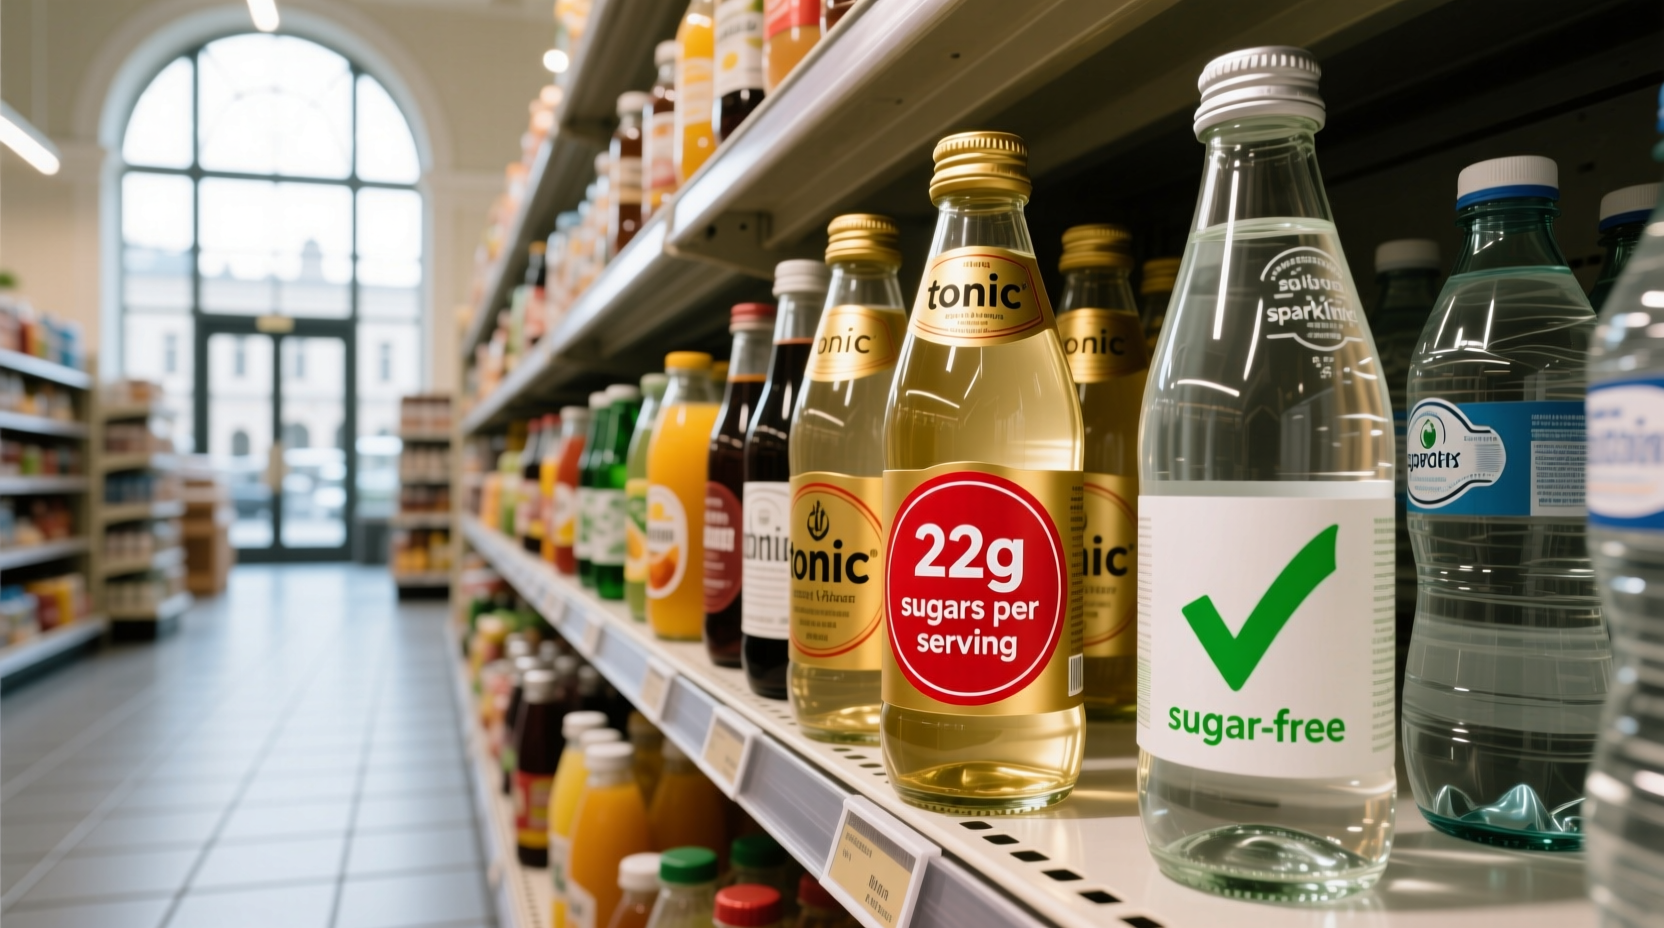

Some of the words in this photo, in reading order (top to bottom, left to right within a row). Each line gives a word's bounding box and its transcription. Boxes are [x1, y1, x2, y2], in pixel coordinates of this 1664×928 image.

[914, 523, 1024, 593] 22g
[901, 596, 985, 626] sugars
[993, 600, 1039, 627] per
[916, 629, 1018, 662] serving
[1168, 706, 1346, 746] sugar-free
